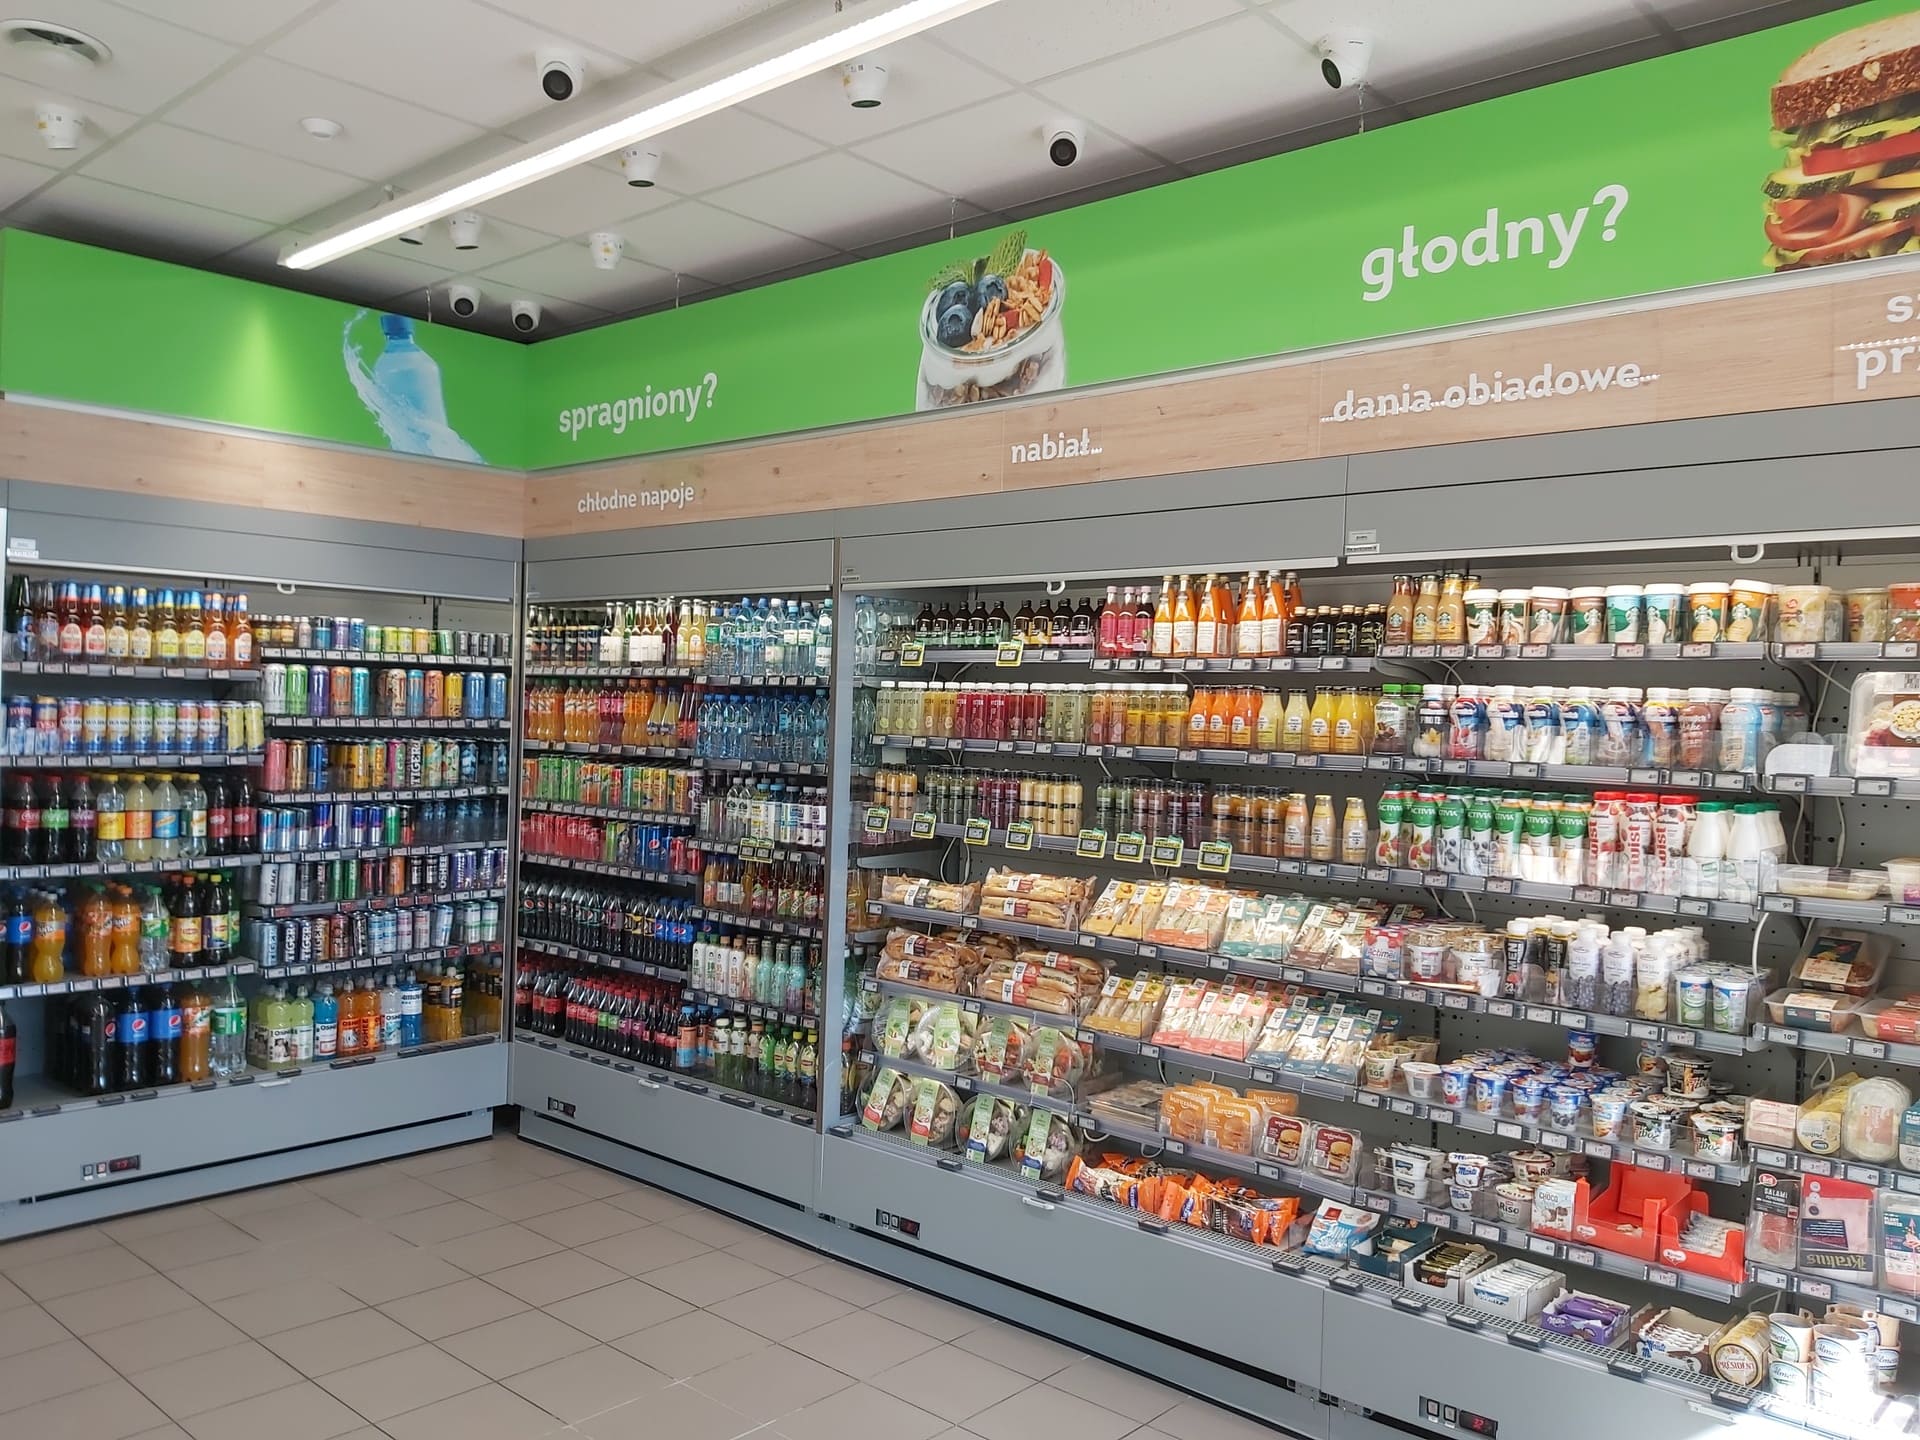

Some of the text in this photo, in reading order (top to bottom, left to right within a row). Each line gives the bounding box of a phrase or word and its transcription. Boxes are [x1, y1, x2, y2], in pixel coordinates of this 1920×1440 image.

[1361, 183, 1630, 302] głodny?
[1886, 294, 1920, 323] s
[1855, 345, 1920, 391] pr
[559, 372, 718, 442] spragniony?
[1333, 363, 1642, 422] dania obiadowe
[1010, 427, 1090, 464] nabiał
[577, 481, 695, 513] chłodne napoje
[410, 741, 422, 786] TIGER
[438, 855, 449, 889] OSHEE
[284, 926, 296, 963] TIGER
[301, 925, 312, 963] TIGER
[1507, 941, 1519, 971] MEN
[1212, 1106, 1245, 1119] kurczaker
[1500, 1201, 1520, 1215] Riso
[1538, 1191, 1559, 1203] CHOCO
[1763, 1187, 1788, 1199] SALAMI
[1806, 1252, 1866, 1271] Krakus
